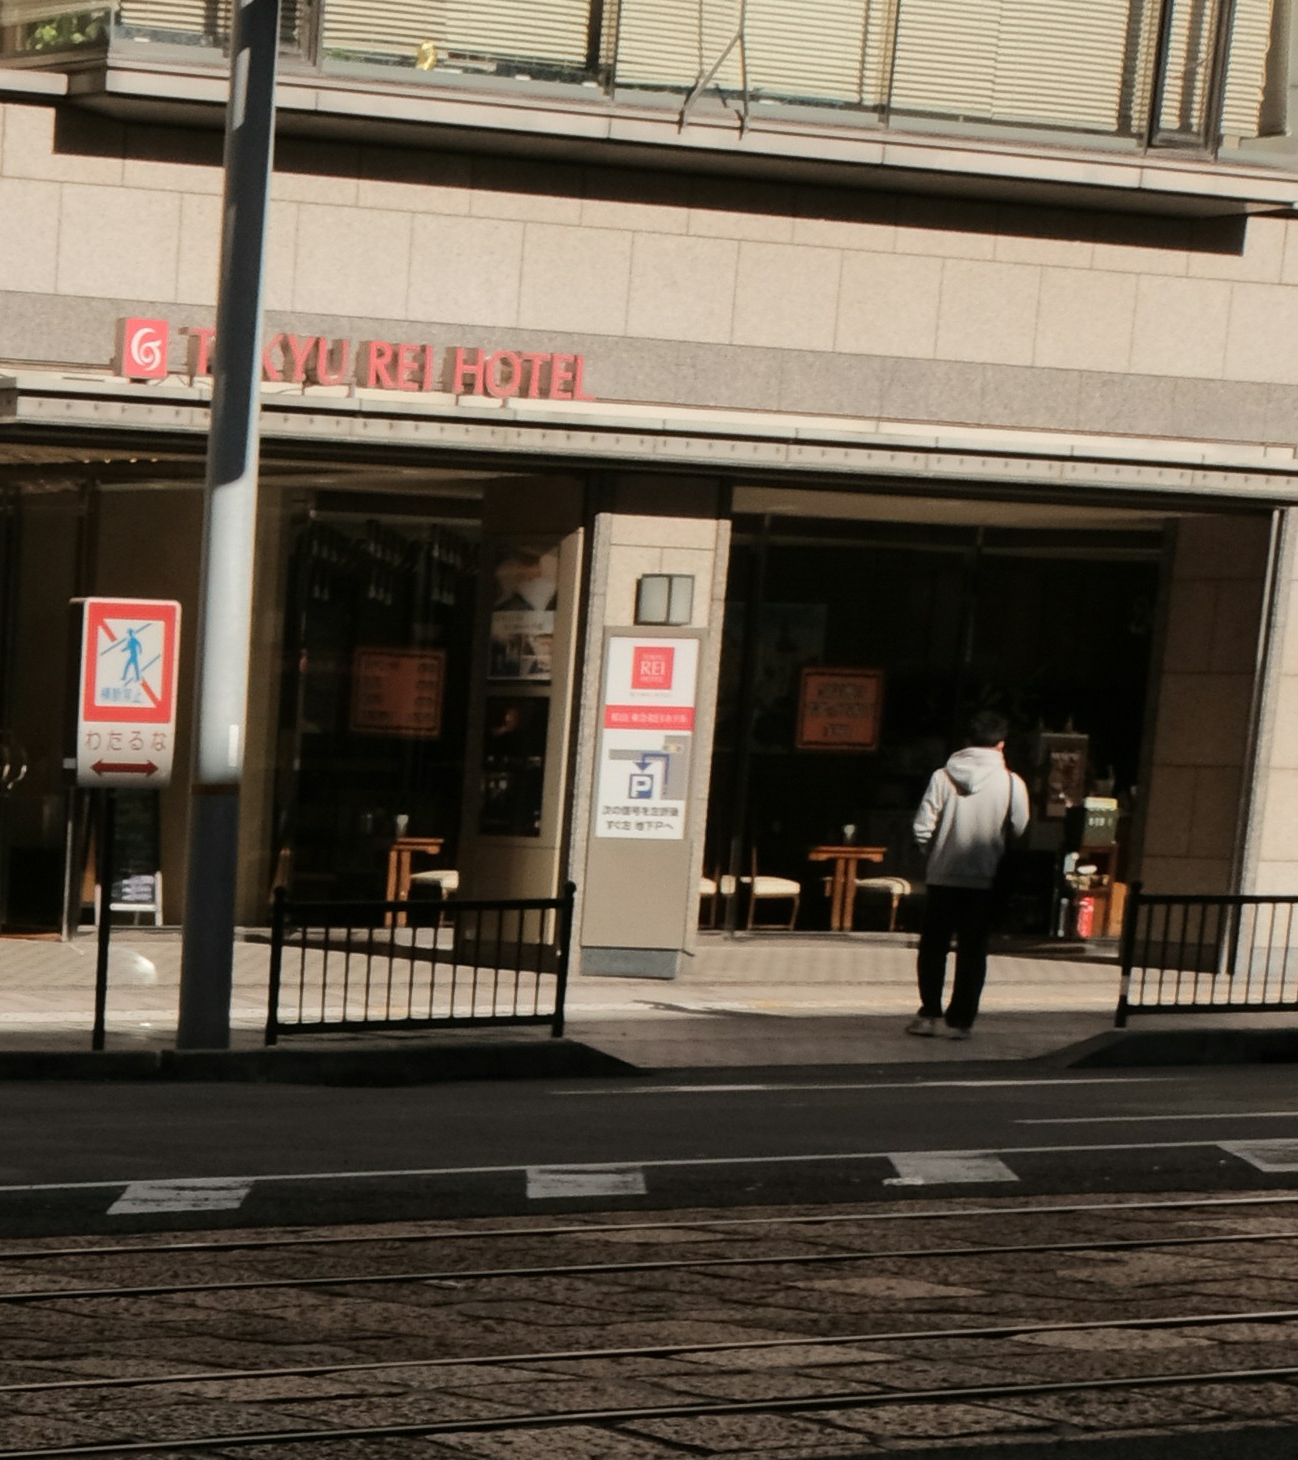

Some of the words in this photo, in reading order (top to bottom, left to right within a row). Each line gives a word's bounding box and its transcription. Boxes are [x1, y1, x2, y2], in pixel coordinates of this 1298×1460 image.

[185, 327, 351, 387] TKYU
[367, 339, 433, 392] REI
[453, 347, 596, 402] HOTEL
[640, 660, 666, 676] REI
[84, 730, 168, 753] わたるな
